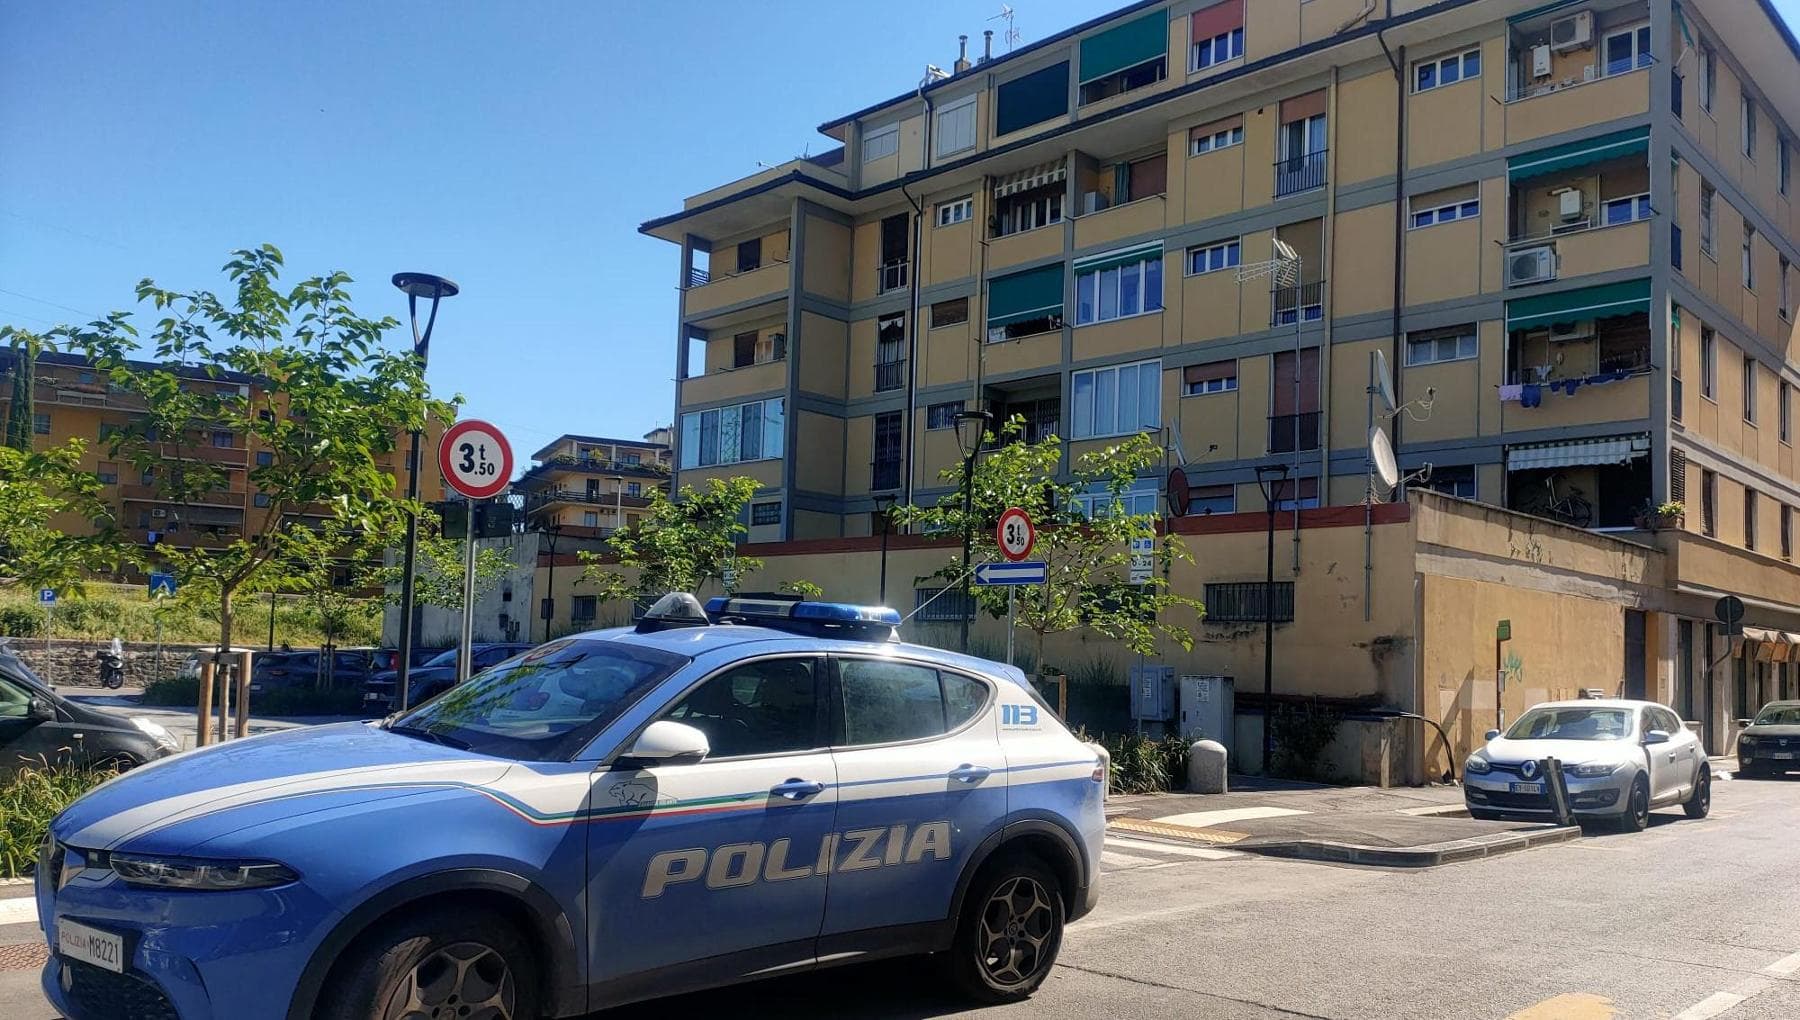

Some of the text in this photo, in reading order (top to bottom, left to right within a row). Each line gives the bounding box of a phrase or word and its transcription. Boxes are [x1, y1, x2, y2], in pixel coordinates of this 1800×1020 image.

[459, 443, 475, 473] 3
[479, 444, 486, 460] t
[1007, 524, 1015, 544] 3
[1016, 537, 1025, 546] 50
[44, 591, 53, 600] P
[1001, 705, 1037, 725] 113
[639, 820, 951, 900] POLIZIA
[89, 935, 118, 965] M8221
